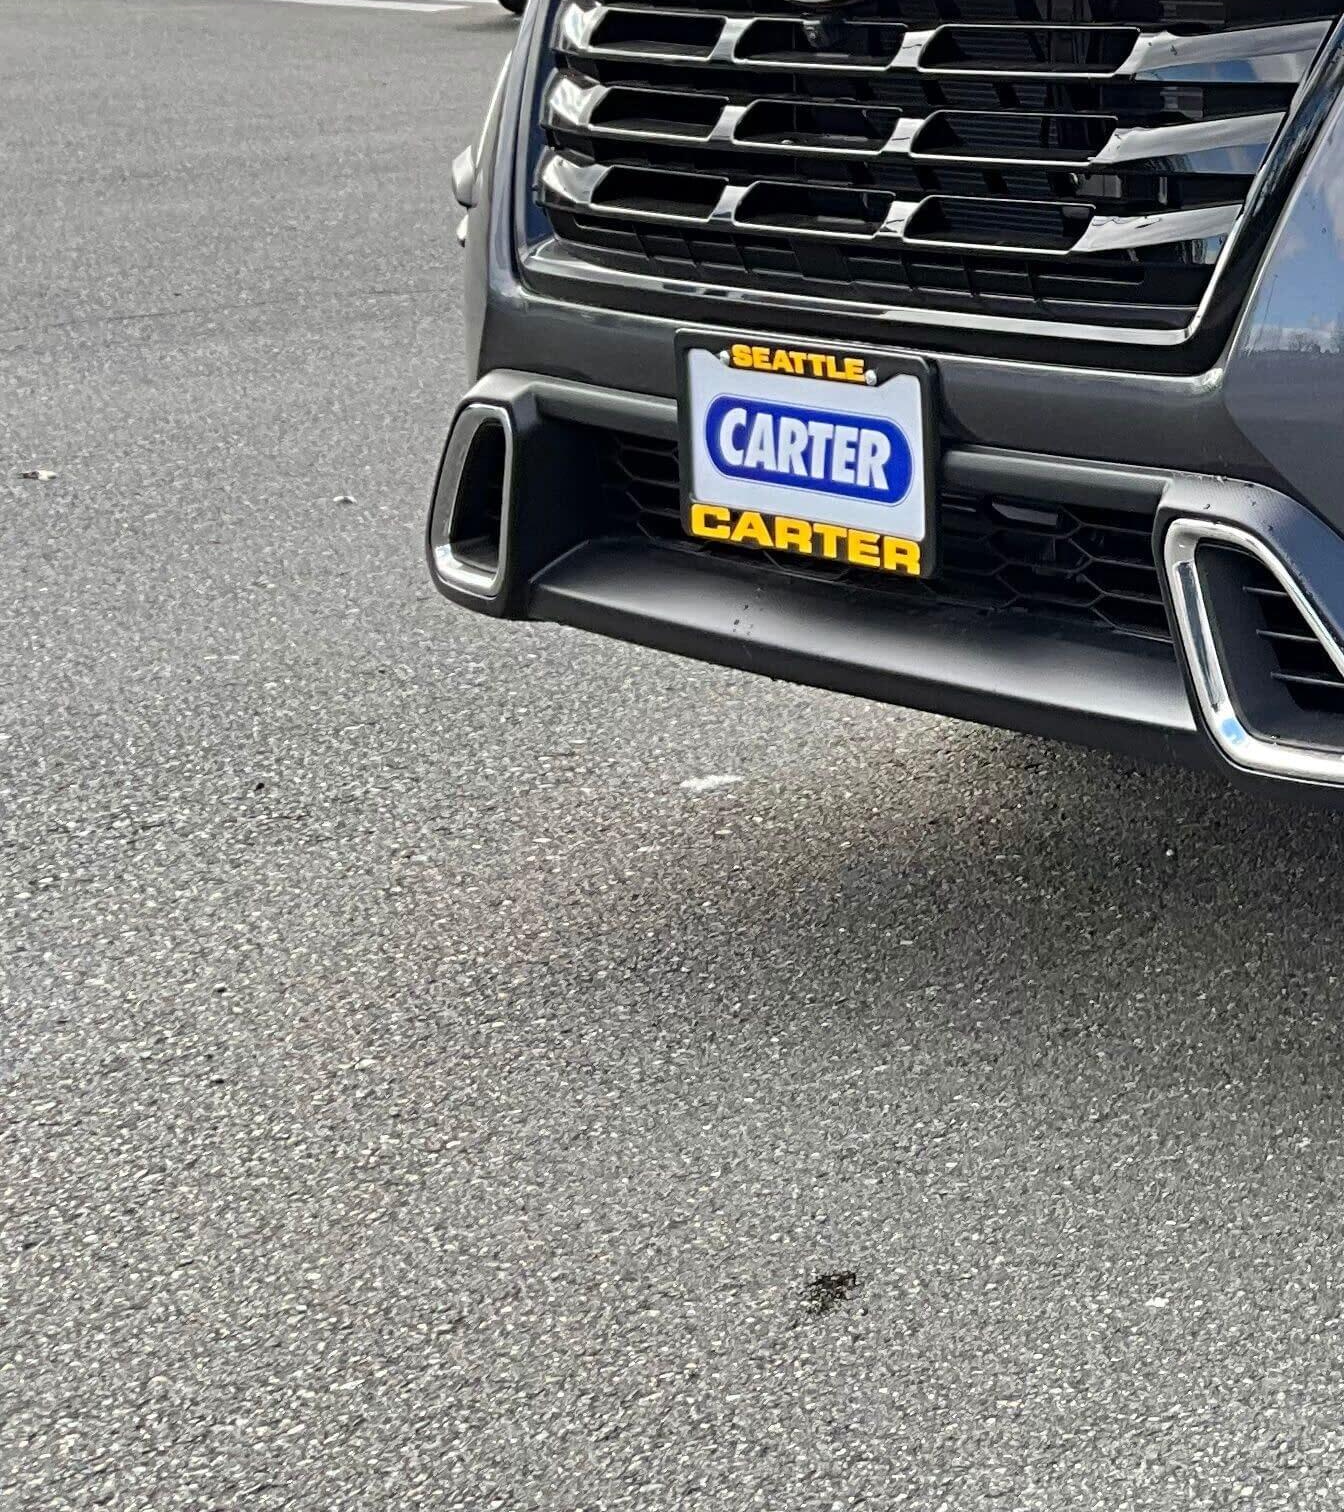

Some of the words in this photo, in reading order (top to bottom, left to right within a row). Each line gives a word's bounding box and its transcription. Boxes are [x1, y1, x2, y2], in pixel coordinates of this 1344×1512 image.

[731, 344, 866, 382] SEATTLE
[720, 408, 891, 491] CARTER
[691, 503, 921, 576] CARTER
